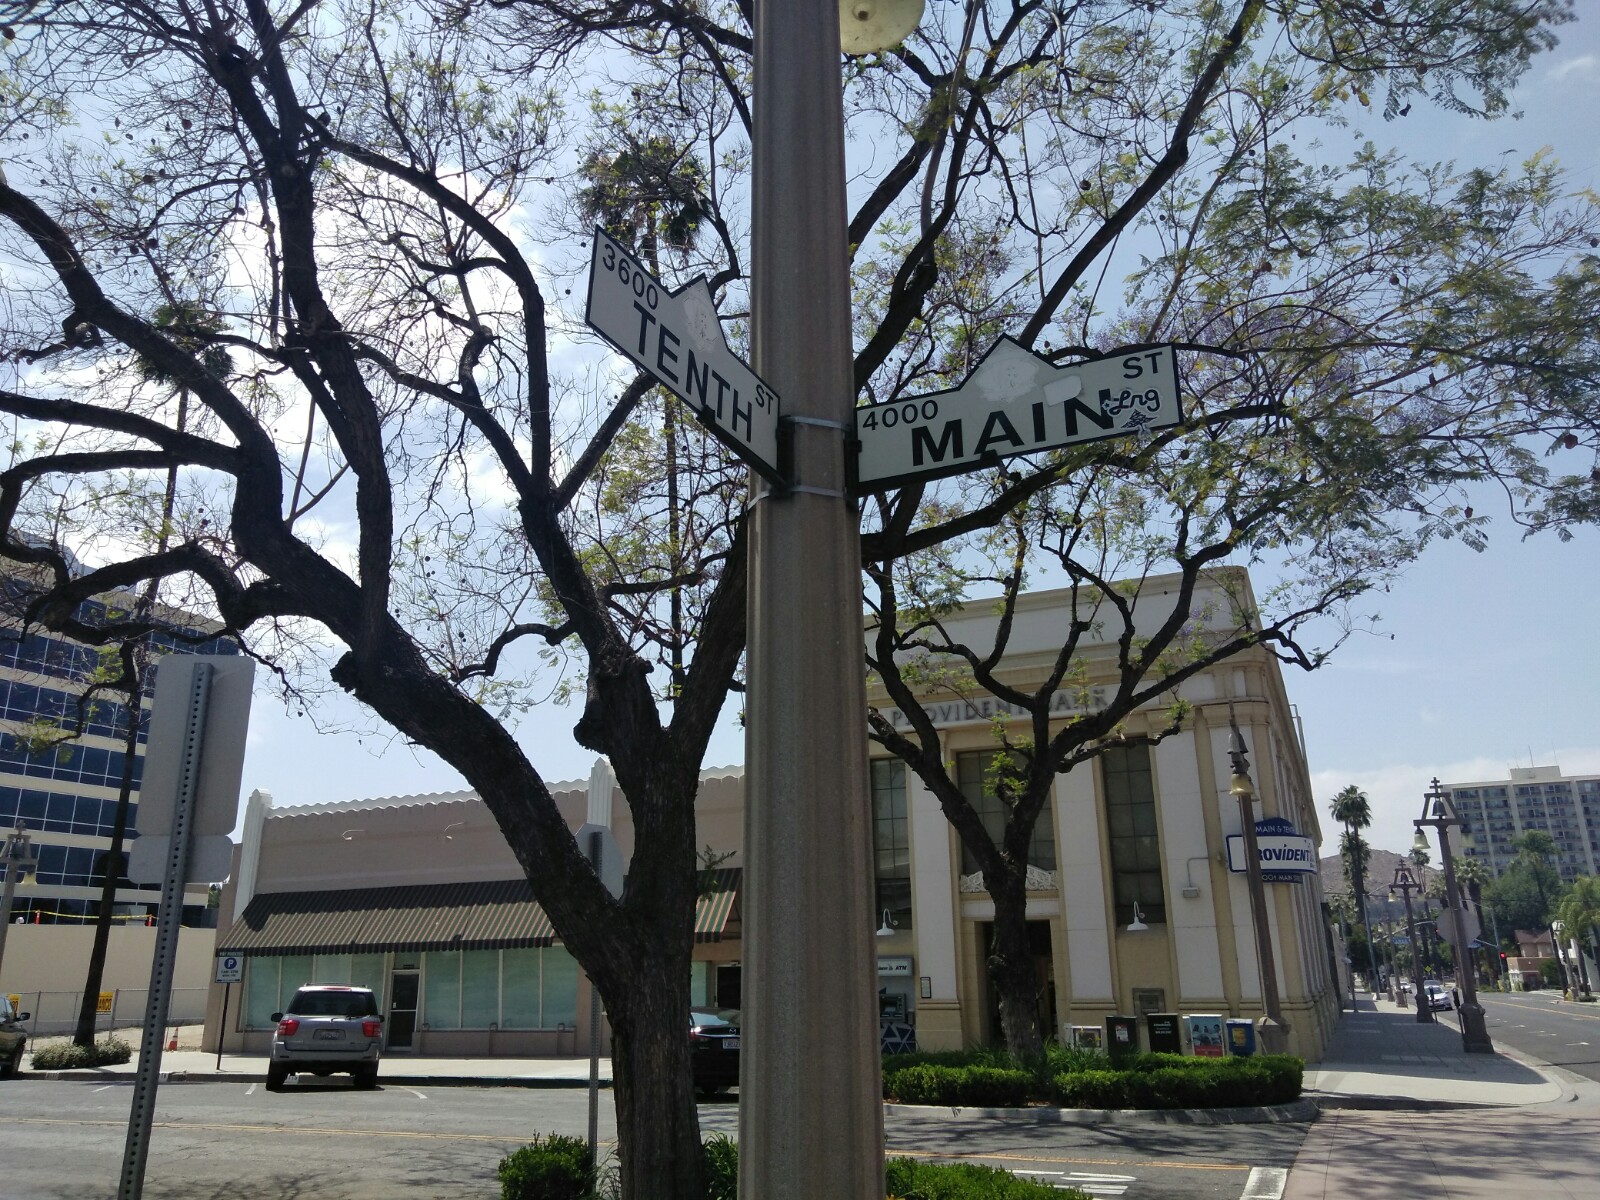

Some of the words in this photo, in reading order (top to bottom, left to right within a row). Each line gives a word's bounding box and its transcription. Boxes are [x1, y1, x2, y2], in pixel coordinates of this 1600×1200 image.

[602, 243, 658, 310] 3600
[633, 299, 753, 443] TENTH
[755, 383, 774, 415] ST
[1122, 351, 1163, 379] ST
[862, 399, 938, 431] 4000
[910, 388, 1114, 467] MAIN
[892, 698, 1026, 726] POVIDENT
[1255, 825, 1276, 833] MAIN
[1257, 846, 1310, 862] ROVIDENT
